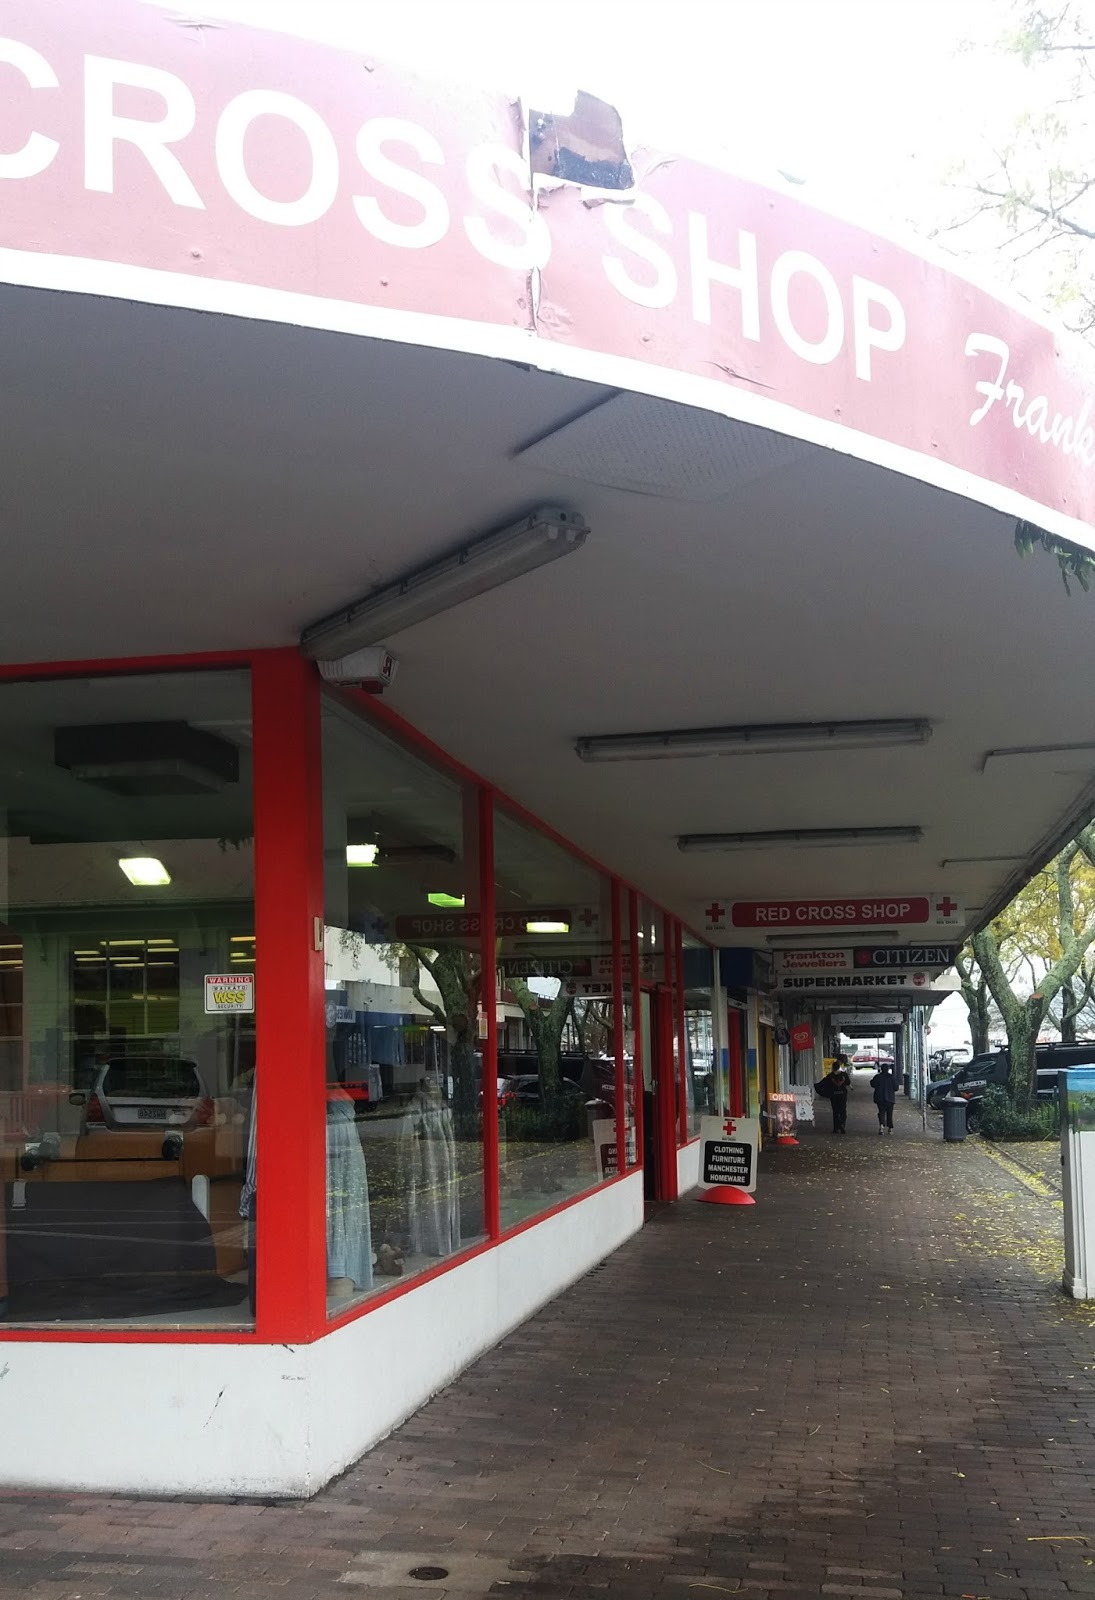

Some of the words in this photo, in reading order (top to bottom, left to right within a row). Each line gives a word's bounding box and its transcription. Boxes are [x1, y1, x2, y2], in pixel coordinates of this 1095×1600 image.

[0, 36, 552, 270] CROSS
[602, 188, 907, 382] SHOP
[756, 907, 790, 921] RED
[796, 905, 856, 920] CROSS
[862, 903, 911, 918] SHOP
[783, 951, 845, 960] Frankton
[872, 949, 950, 965] CITIZEN
[782, 960, 848, 969] Jewellers
[783, 974, 908, 988] SUPERMARKET
[213, 991, 246, 1004] WSS
[772, 1093, 794, 1101] OPEN
[713, 1145, 744, 1154] CLOTHING
[711, 1154, 746, 1164] FURNITURE
[707, 1164, 749, 1174] MANCHESTER
[710, 1173, 746, 1183] HOMEWARE
